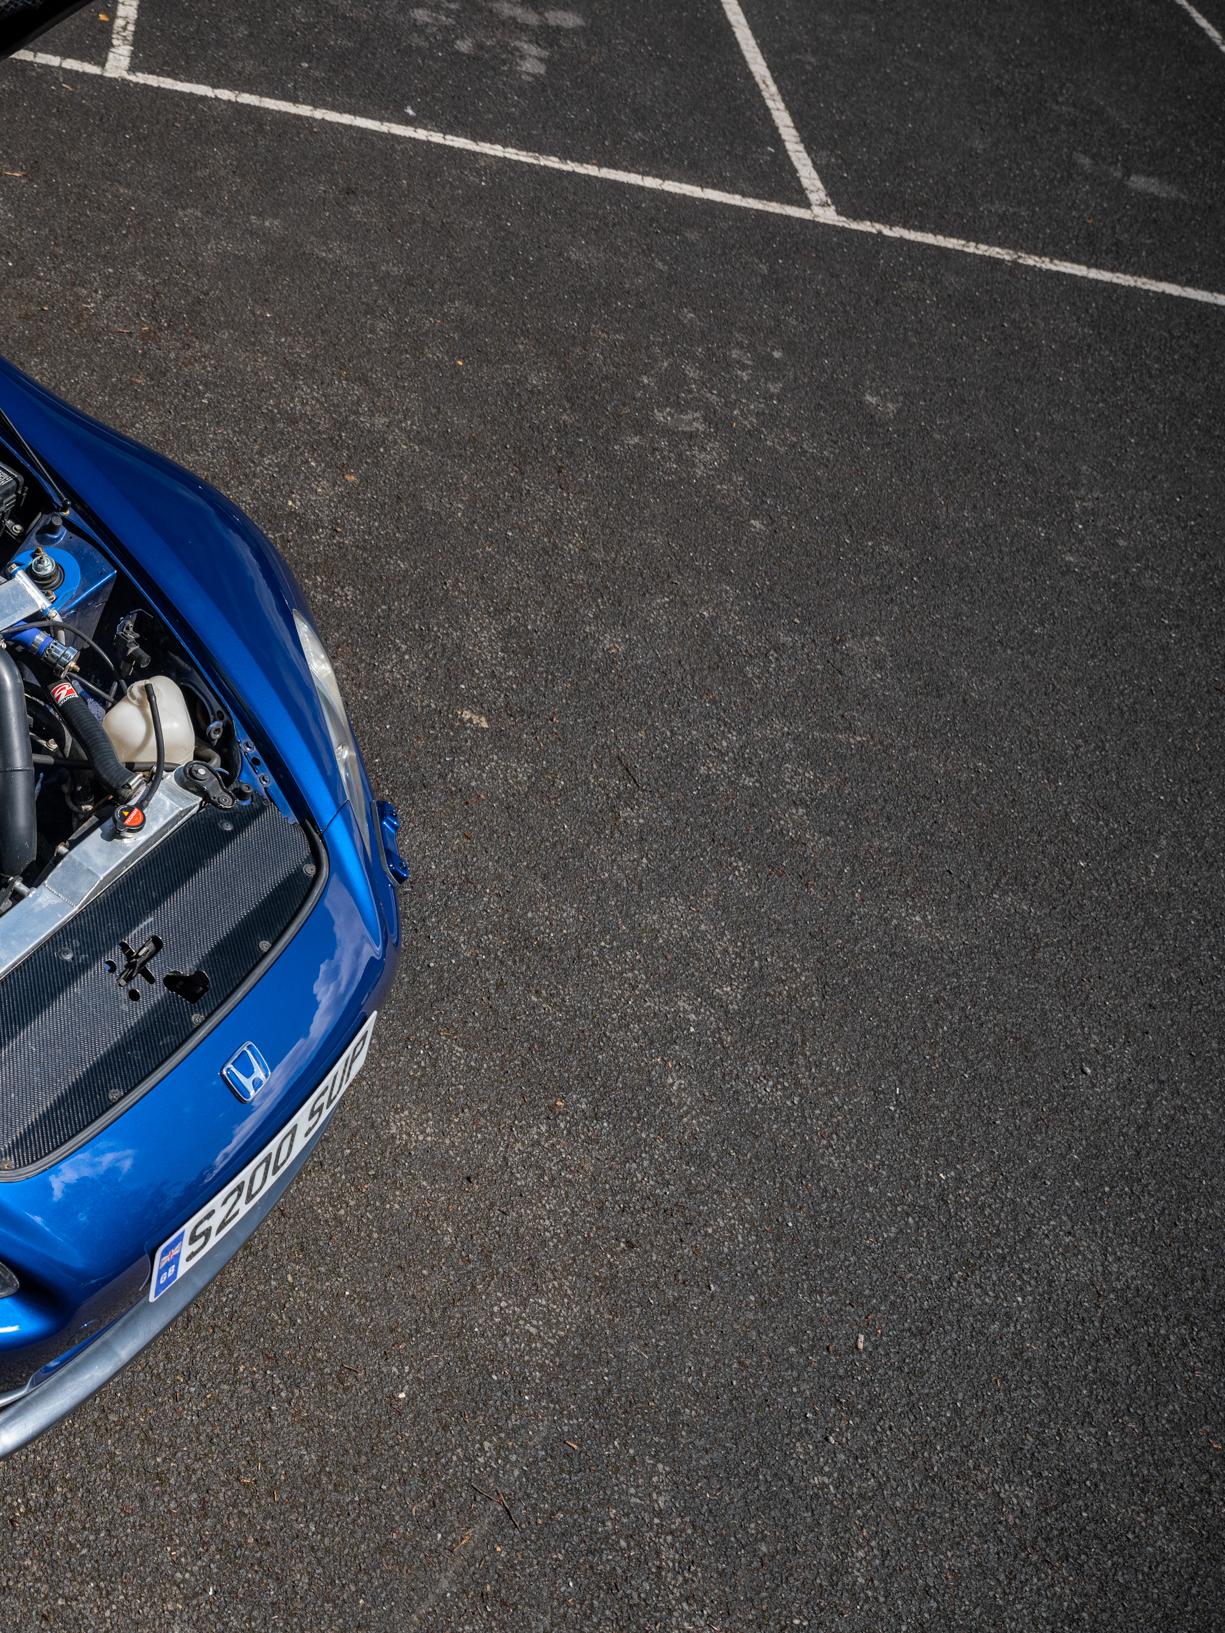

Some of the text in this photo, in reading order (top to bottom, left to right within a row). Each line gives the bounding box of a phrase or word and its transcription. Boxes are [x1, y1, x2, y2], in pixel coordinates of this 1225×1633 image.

[185, 1029, 368, 1263] S200 SUP
[159, 1264, 176, 1285] GB
